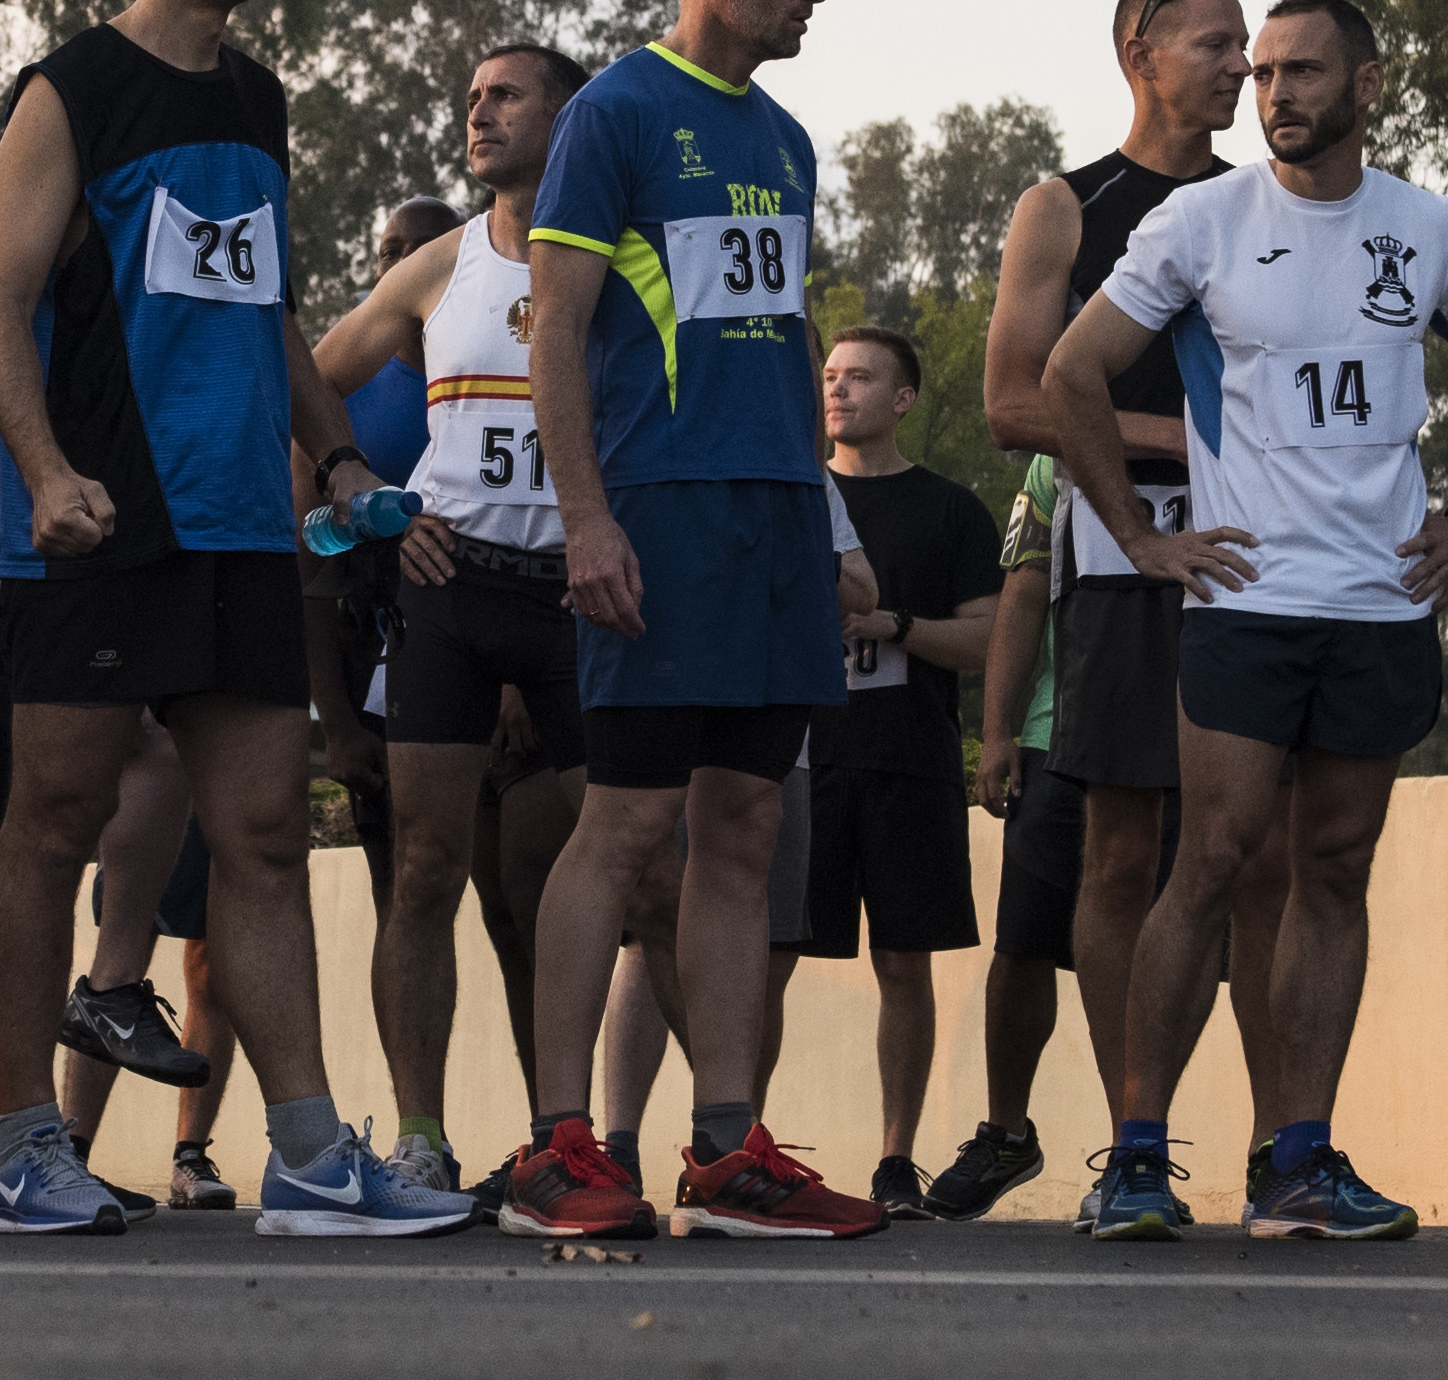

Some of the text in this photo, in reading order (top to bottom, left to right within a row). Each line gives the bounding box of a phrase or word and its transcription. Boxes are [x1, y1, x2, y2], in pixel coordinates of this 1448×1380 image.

[185, 217, 256, 285] 26
[719, 227, 786, 295] 38
[1294, 360, 1371, 428] 14
[479, 426, 546, 491] 51
